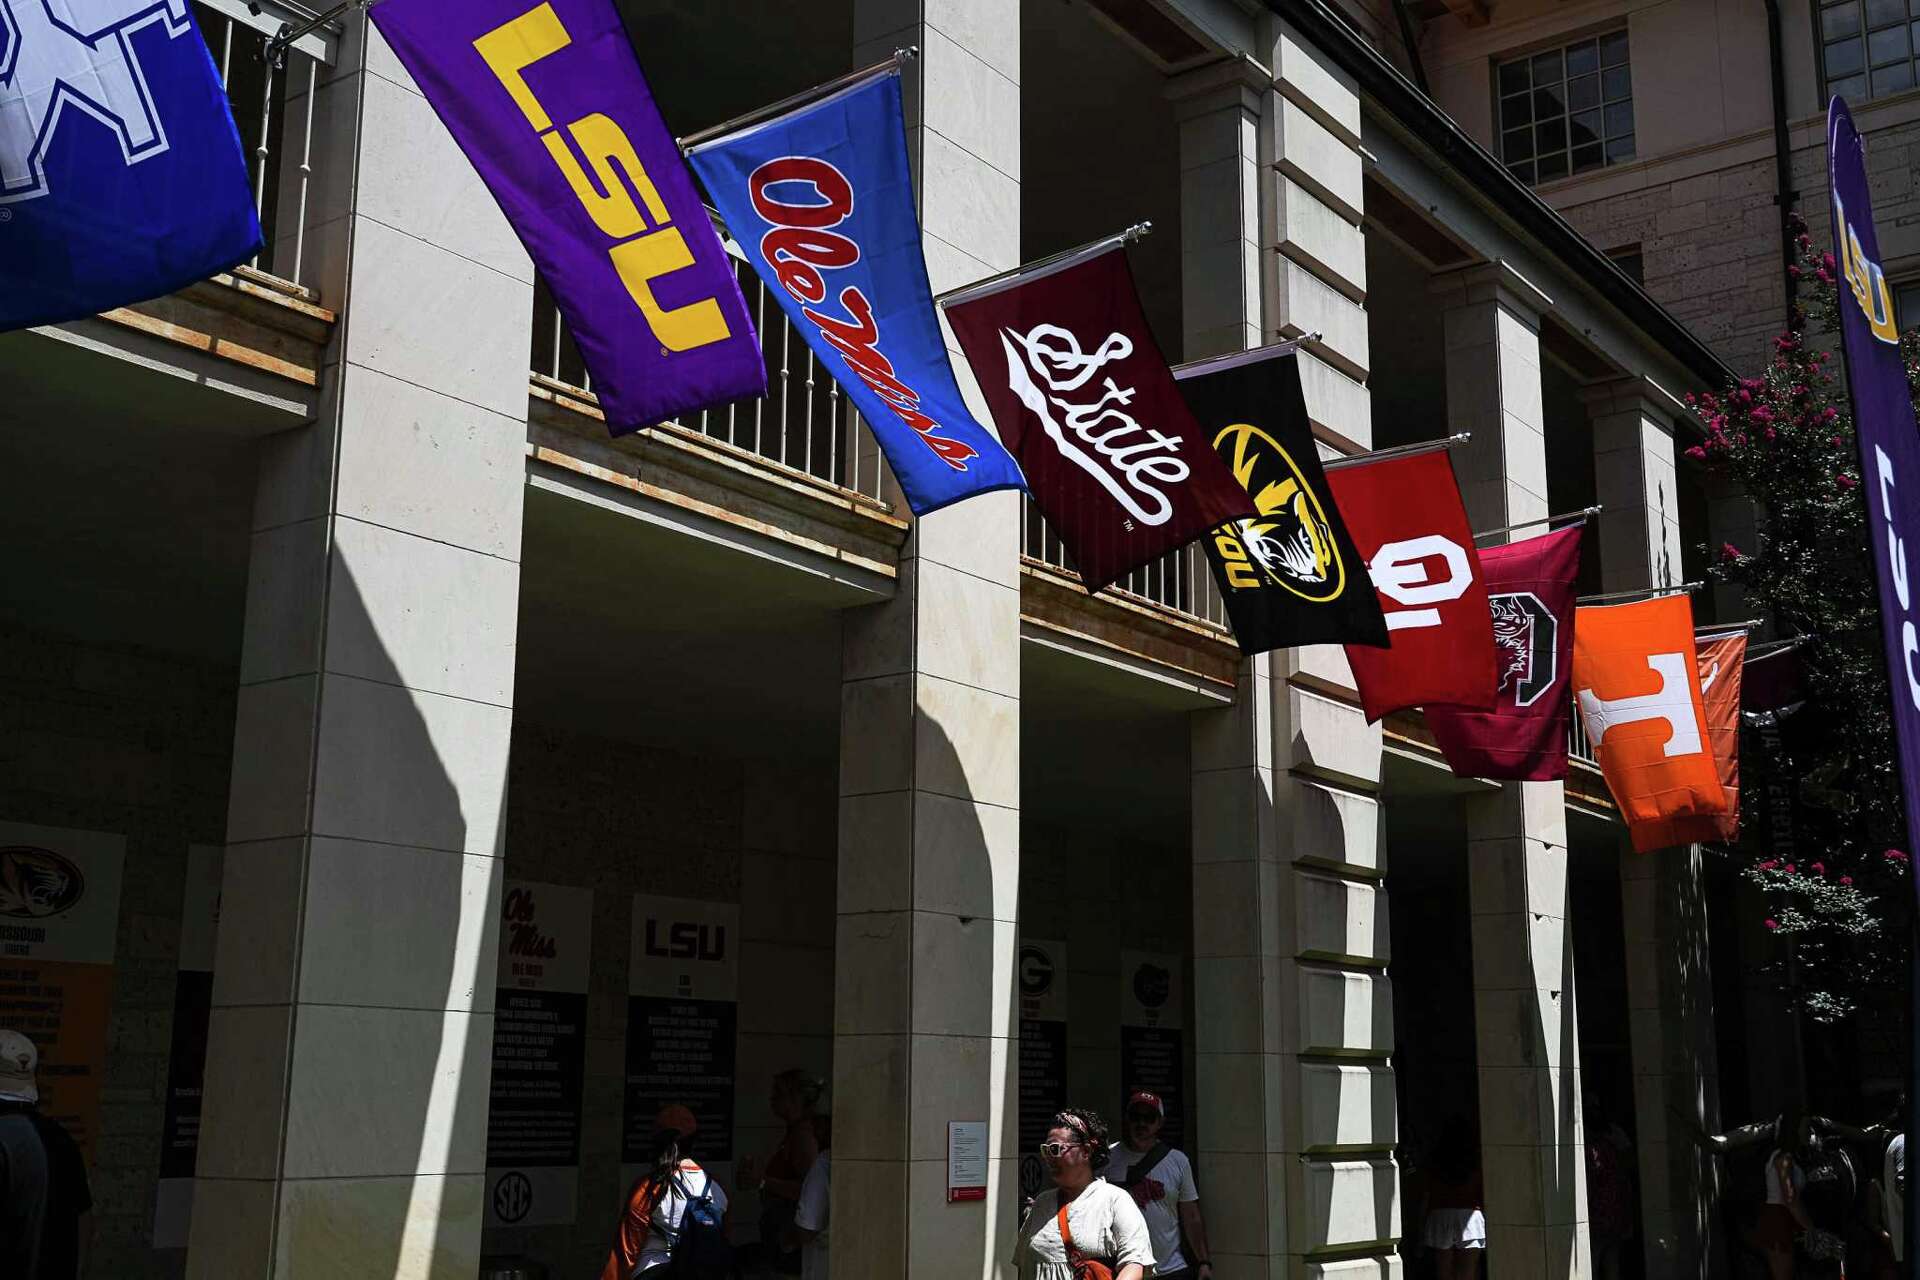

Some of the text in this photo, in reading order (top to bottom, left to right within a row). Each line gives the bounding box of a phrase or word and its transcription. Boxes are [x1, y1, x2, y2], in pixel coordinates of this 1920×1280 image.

[472, 1, 732, 353] LSU
[749, 156, 980, 472] Ole Miss
[999, 323, 1191, 526] State
[1578, 652, 1704, 758] T
[643, 917, 722, 961] LSU
